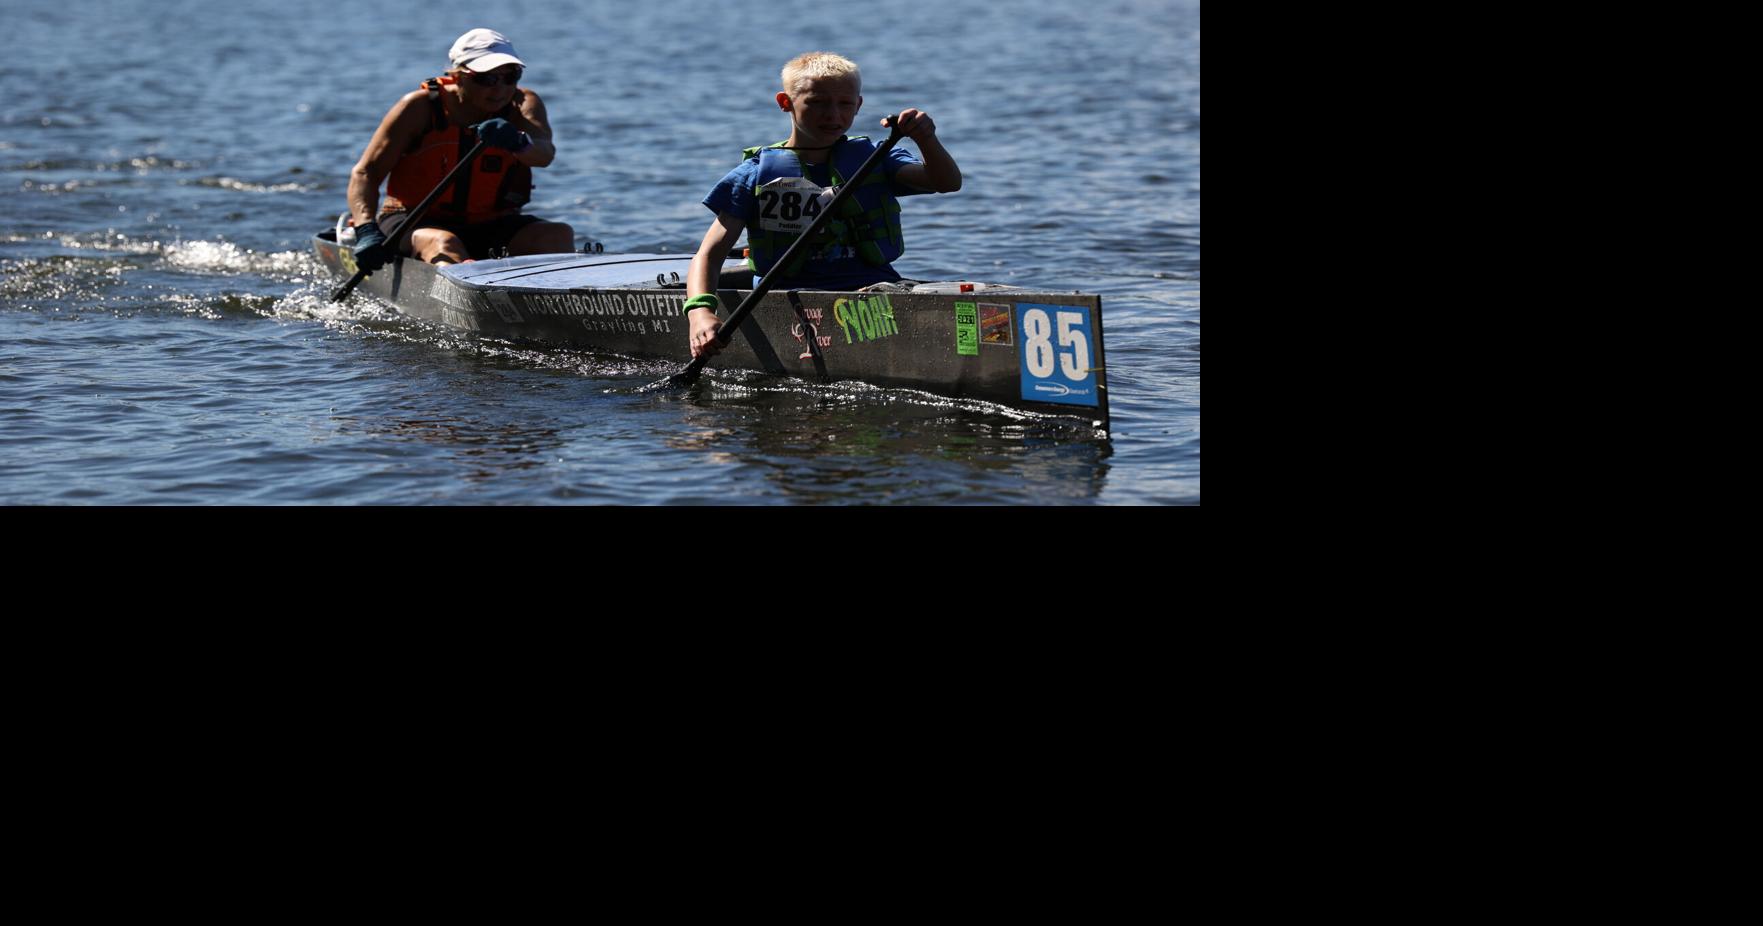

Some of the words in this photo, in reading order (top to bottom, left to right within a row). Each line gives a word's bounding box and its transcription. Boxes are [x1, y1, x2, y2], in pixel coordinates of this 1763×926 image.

[760, 191, 822, 221] 284
[524, 295, 624, 315] NORTHBOUND
[582, 318, 645, 334] Grayling
[652, 319, 671, 333] MI
[1023, 308, 1089, 381] 85
